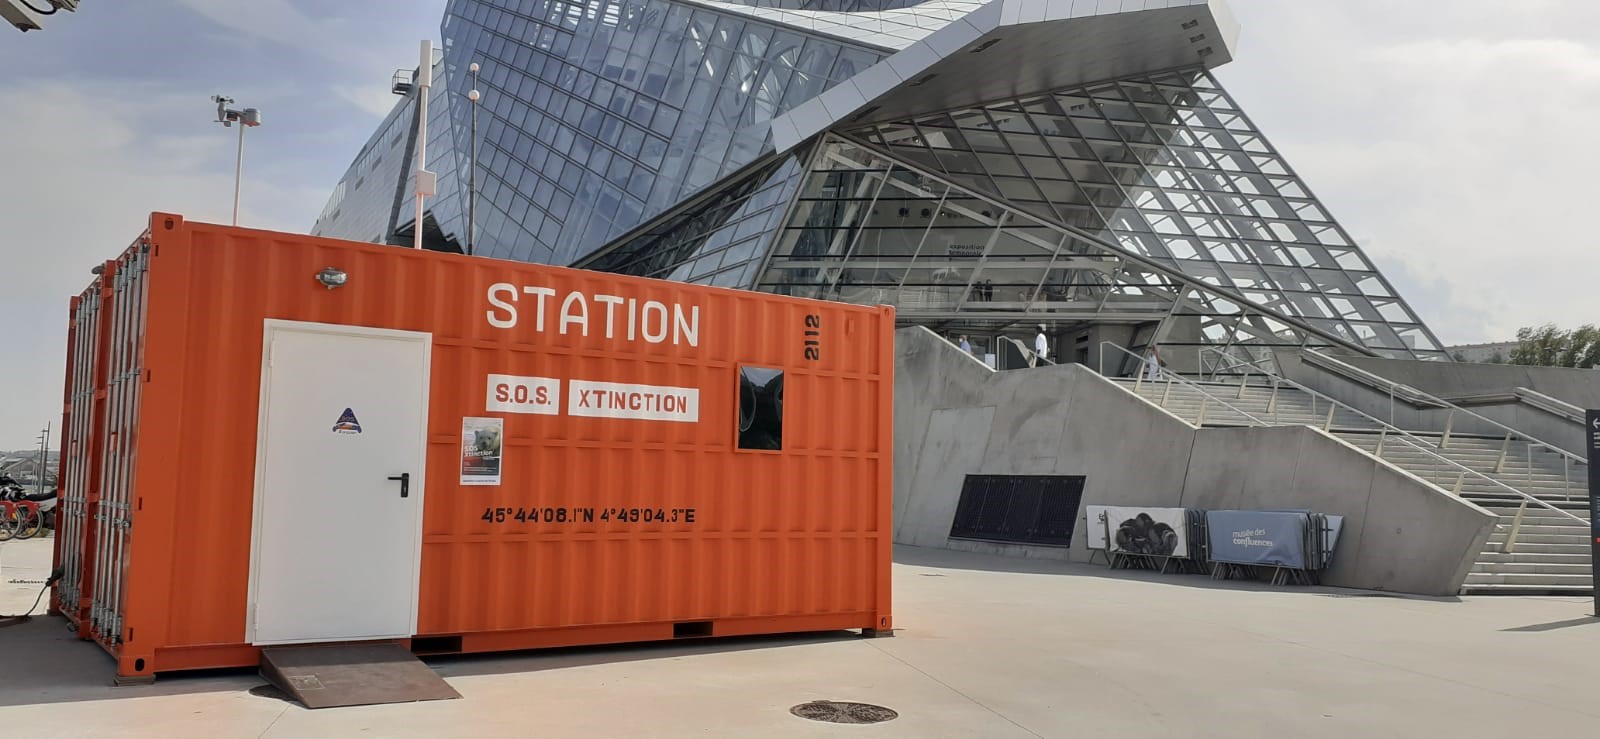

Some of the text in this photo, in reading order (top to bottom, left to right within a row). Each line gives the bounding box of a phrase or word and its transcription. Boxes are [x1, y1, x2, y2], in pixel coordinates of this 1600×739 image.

[486, 282, 699, 347] STATION
[804, 314, 820, 361] 2112
[495, 383, 687, 413] S.O.S. XTINCTION
[1232, 536, 1273, 548] confluences
